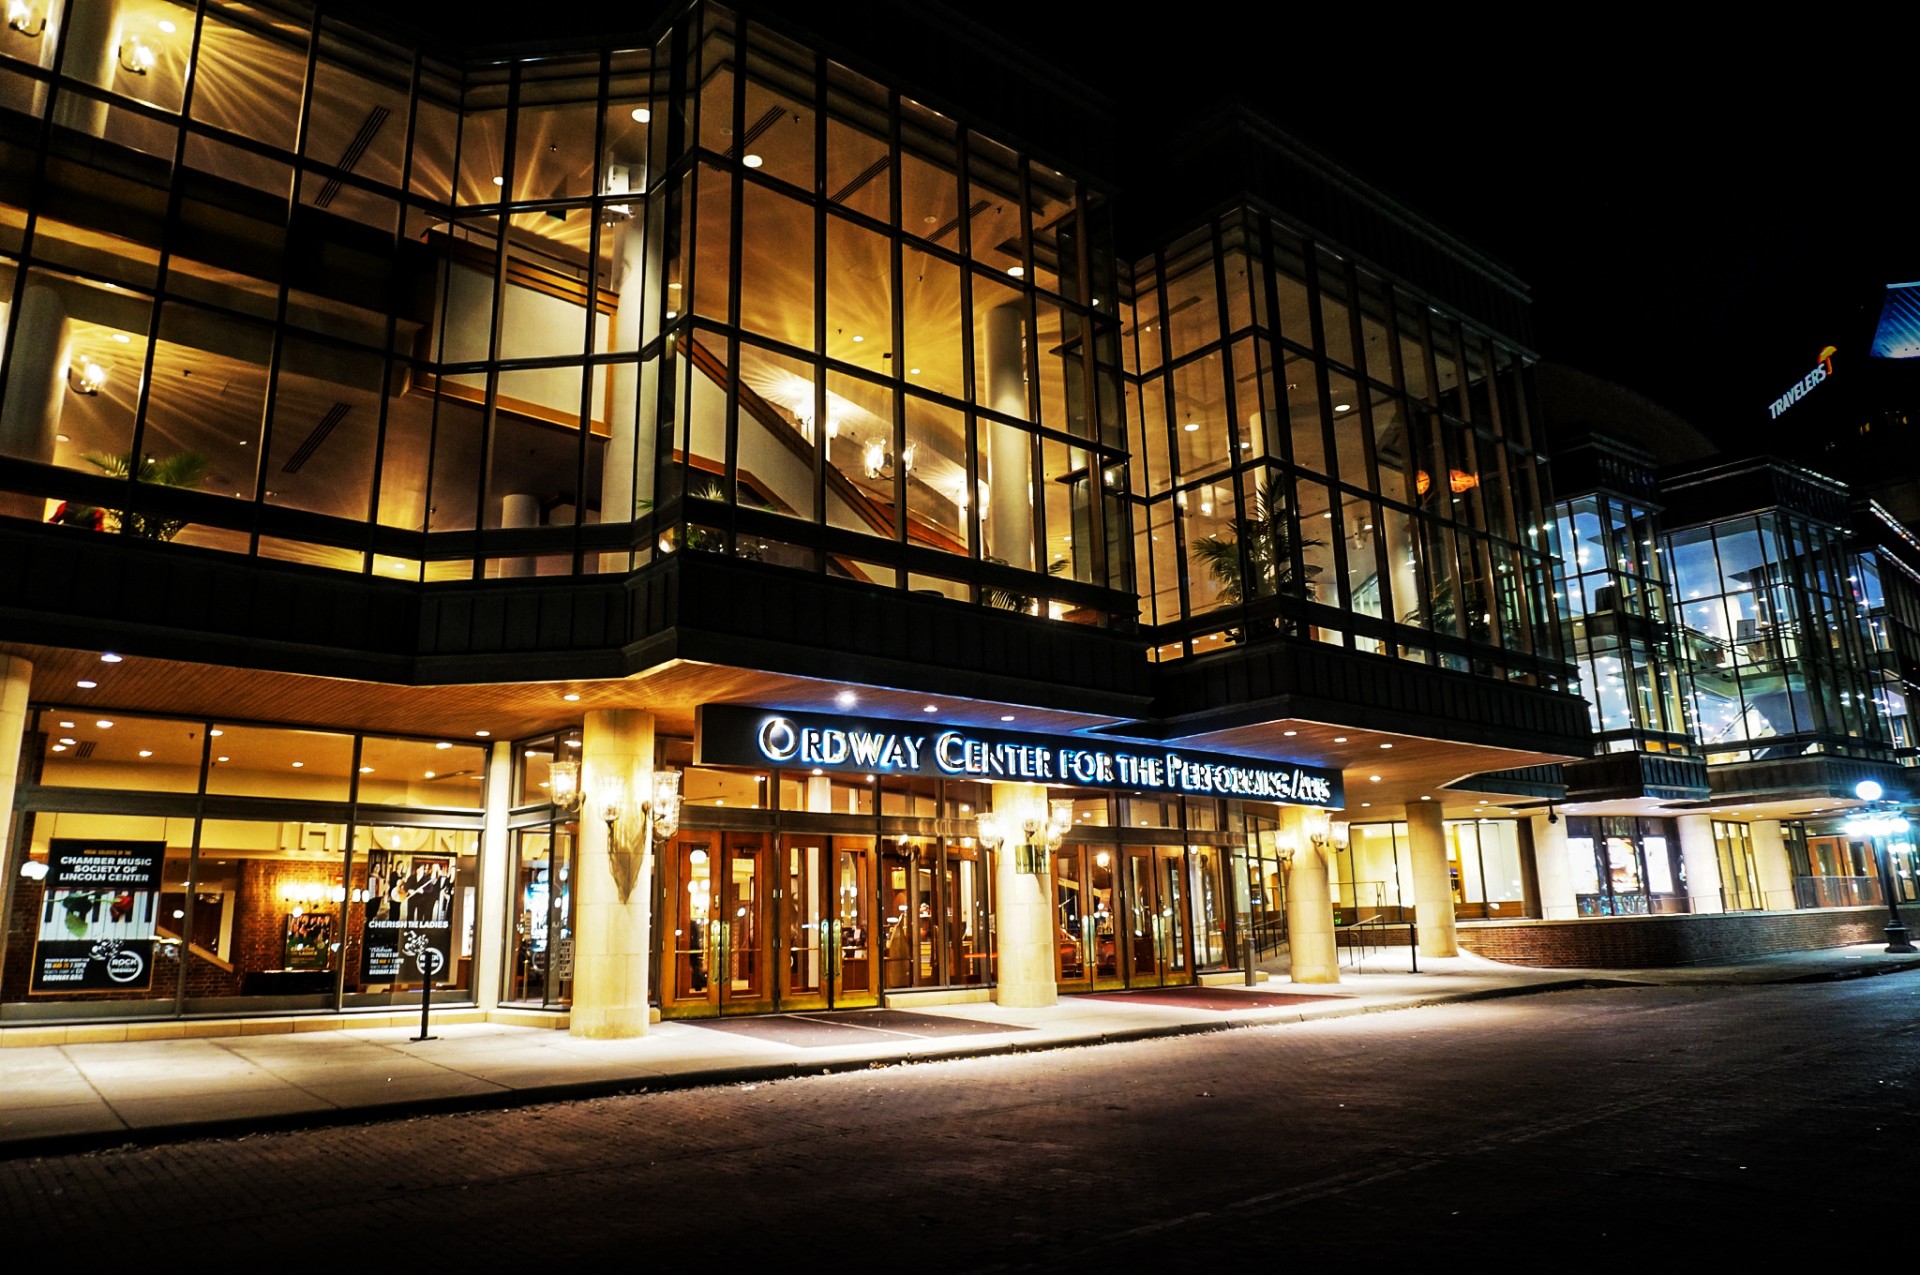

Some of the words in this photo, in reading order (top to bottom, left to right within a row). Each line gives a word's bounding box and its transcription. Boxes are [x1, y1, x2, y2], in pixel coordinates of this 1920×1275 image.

[1768, 363, 1827, 420] TRAVELERS
[758, 717, 926, 769] ORDWAY
[935, 730, 1053, 778] CENTER
[1059, 750, 1115, 783] FOR
[1115, 754, 1164, 787] THE
[1166, 753, 1291, 799] PERFORMING
[60, 856, 116, 866] CHAMBER
[116, 857, 152, 866] MUSIC
[74, 865, 121, 874] SOCIETY
[122, 866, 138, 874] OF
[59, 872, 107, 882] LINCOLN
[107, 873, 150, 882] CENTER
[368, 920, 408, 929] CHERISH
[408, 920, 419, 929] THE
[419, 920, 449, 929] LADIES
[111, 958, 138, 966] ROCK
